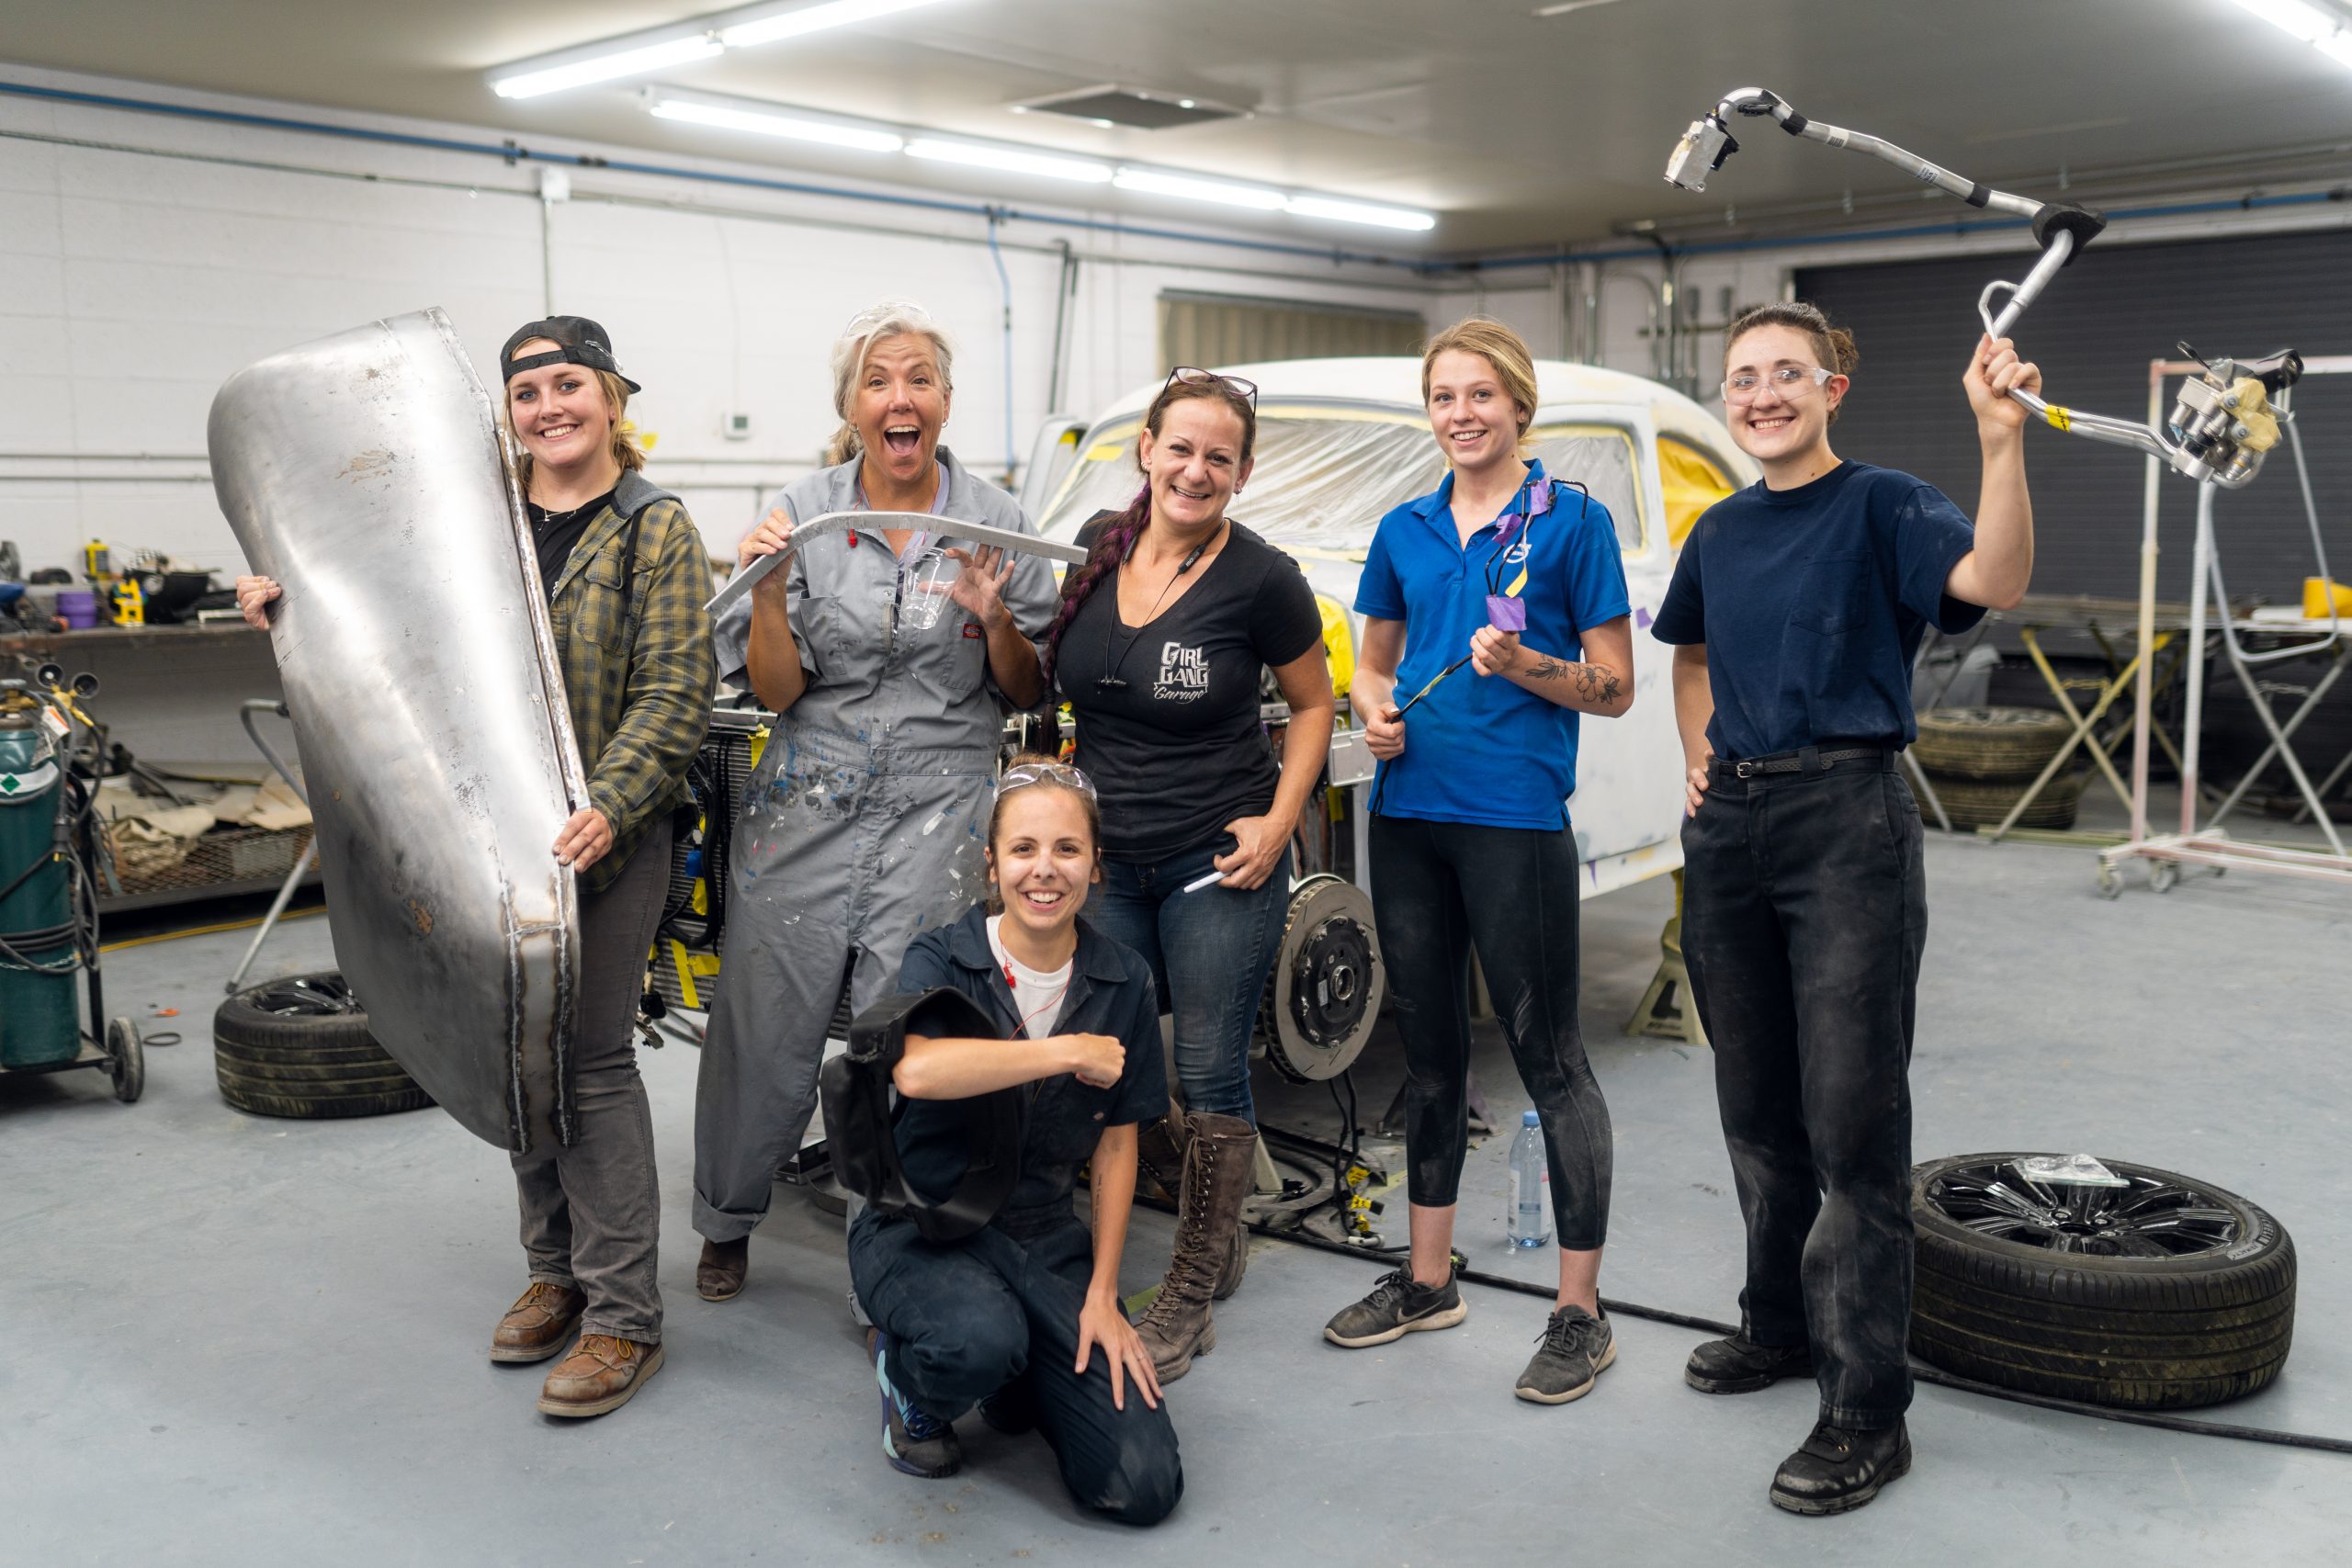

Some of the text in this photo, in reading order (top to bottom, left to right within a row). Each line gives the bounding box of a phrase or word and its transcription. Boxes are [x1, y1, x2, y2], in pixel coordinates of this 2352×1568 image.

[1161, 641, 1208, 669] GIRL
[1160, 666, 1208, 687] GANG
[1154, 686, 1205, 704] Garage
